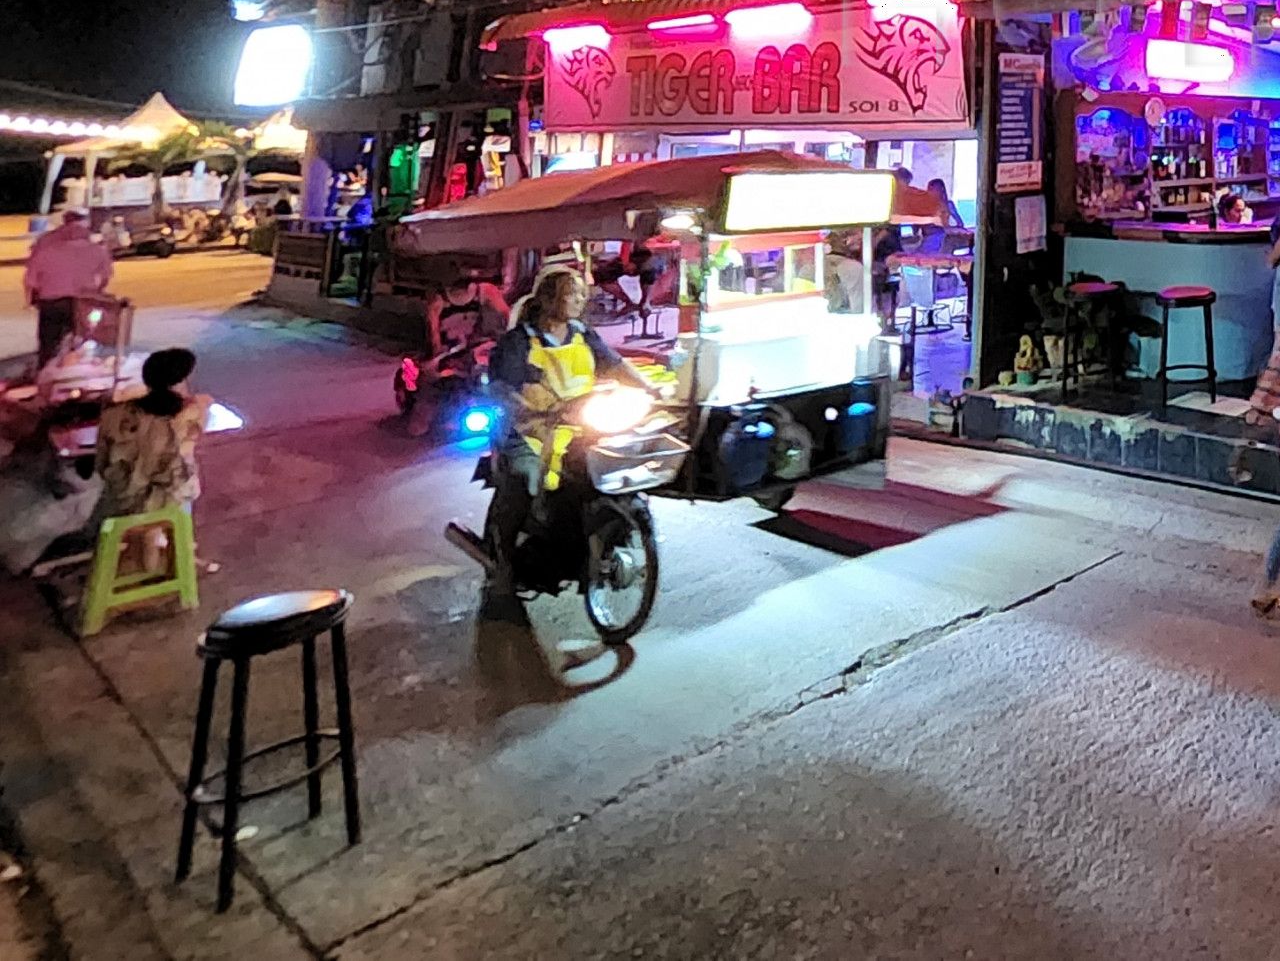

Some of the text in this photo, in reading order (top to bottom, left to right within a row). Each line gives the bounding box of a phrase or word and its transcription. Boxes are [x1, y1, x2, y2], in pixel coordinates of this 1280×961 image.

[626, 42, 842, 116] TIGER BAR
[849, 99, 899, 114] SOI 8
